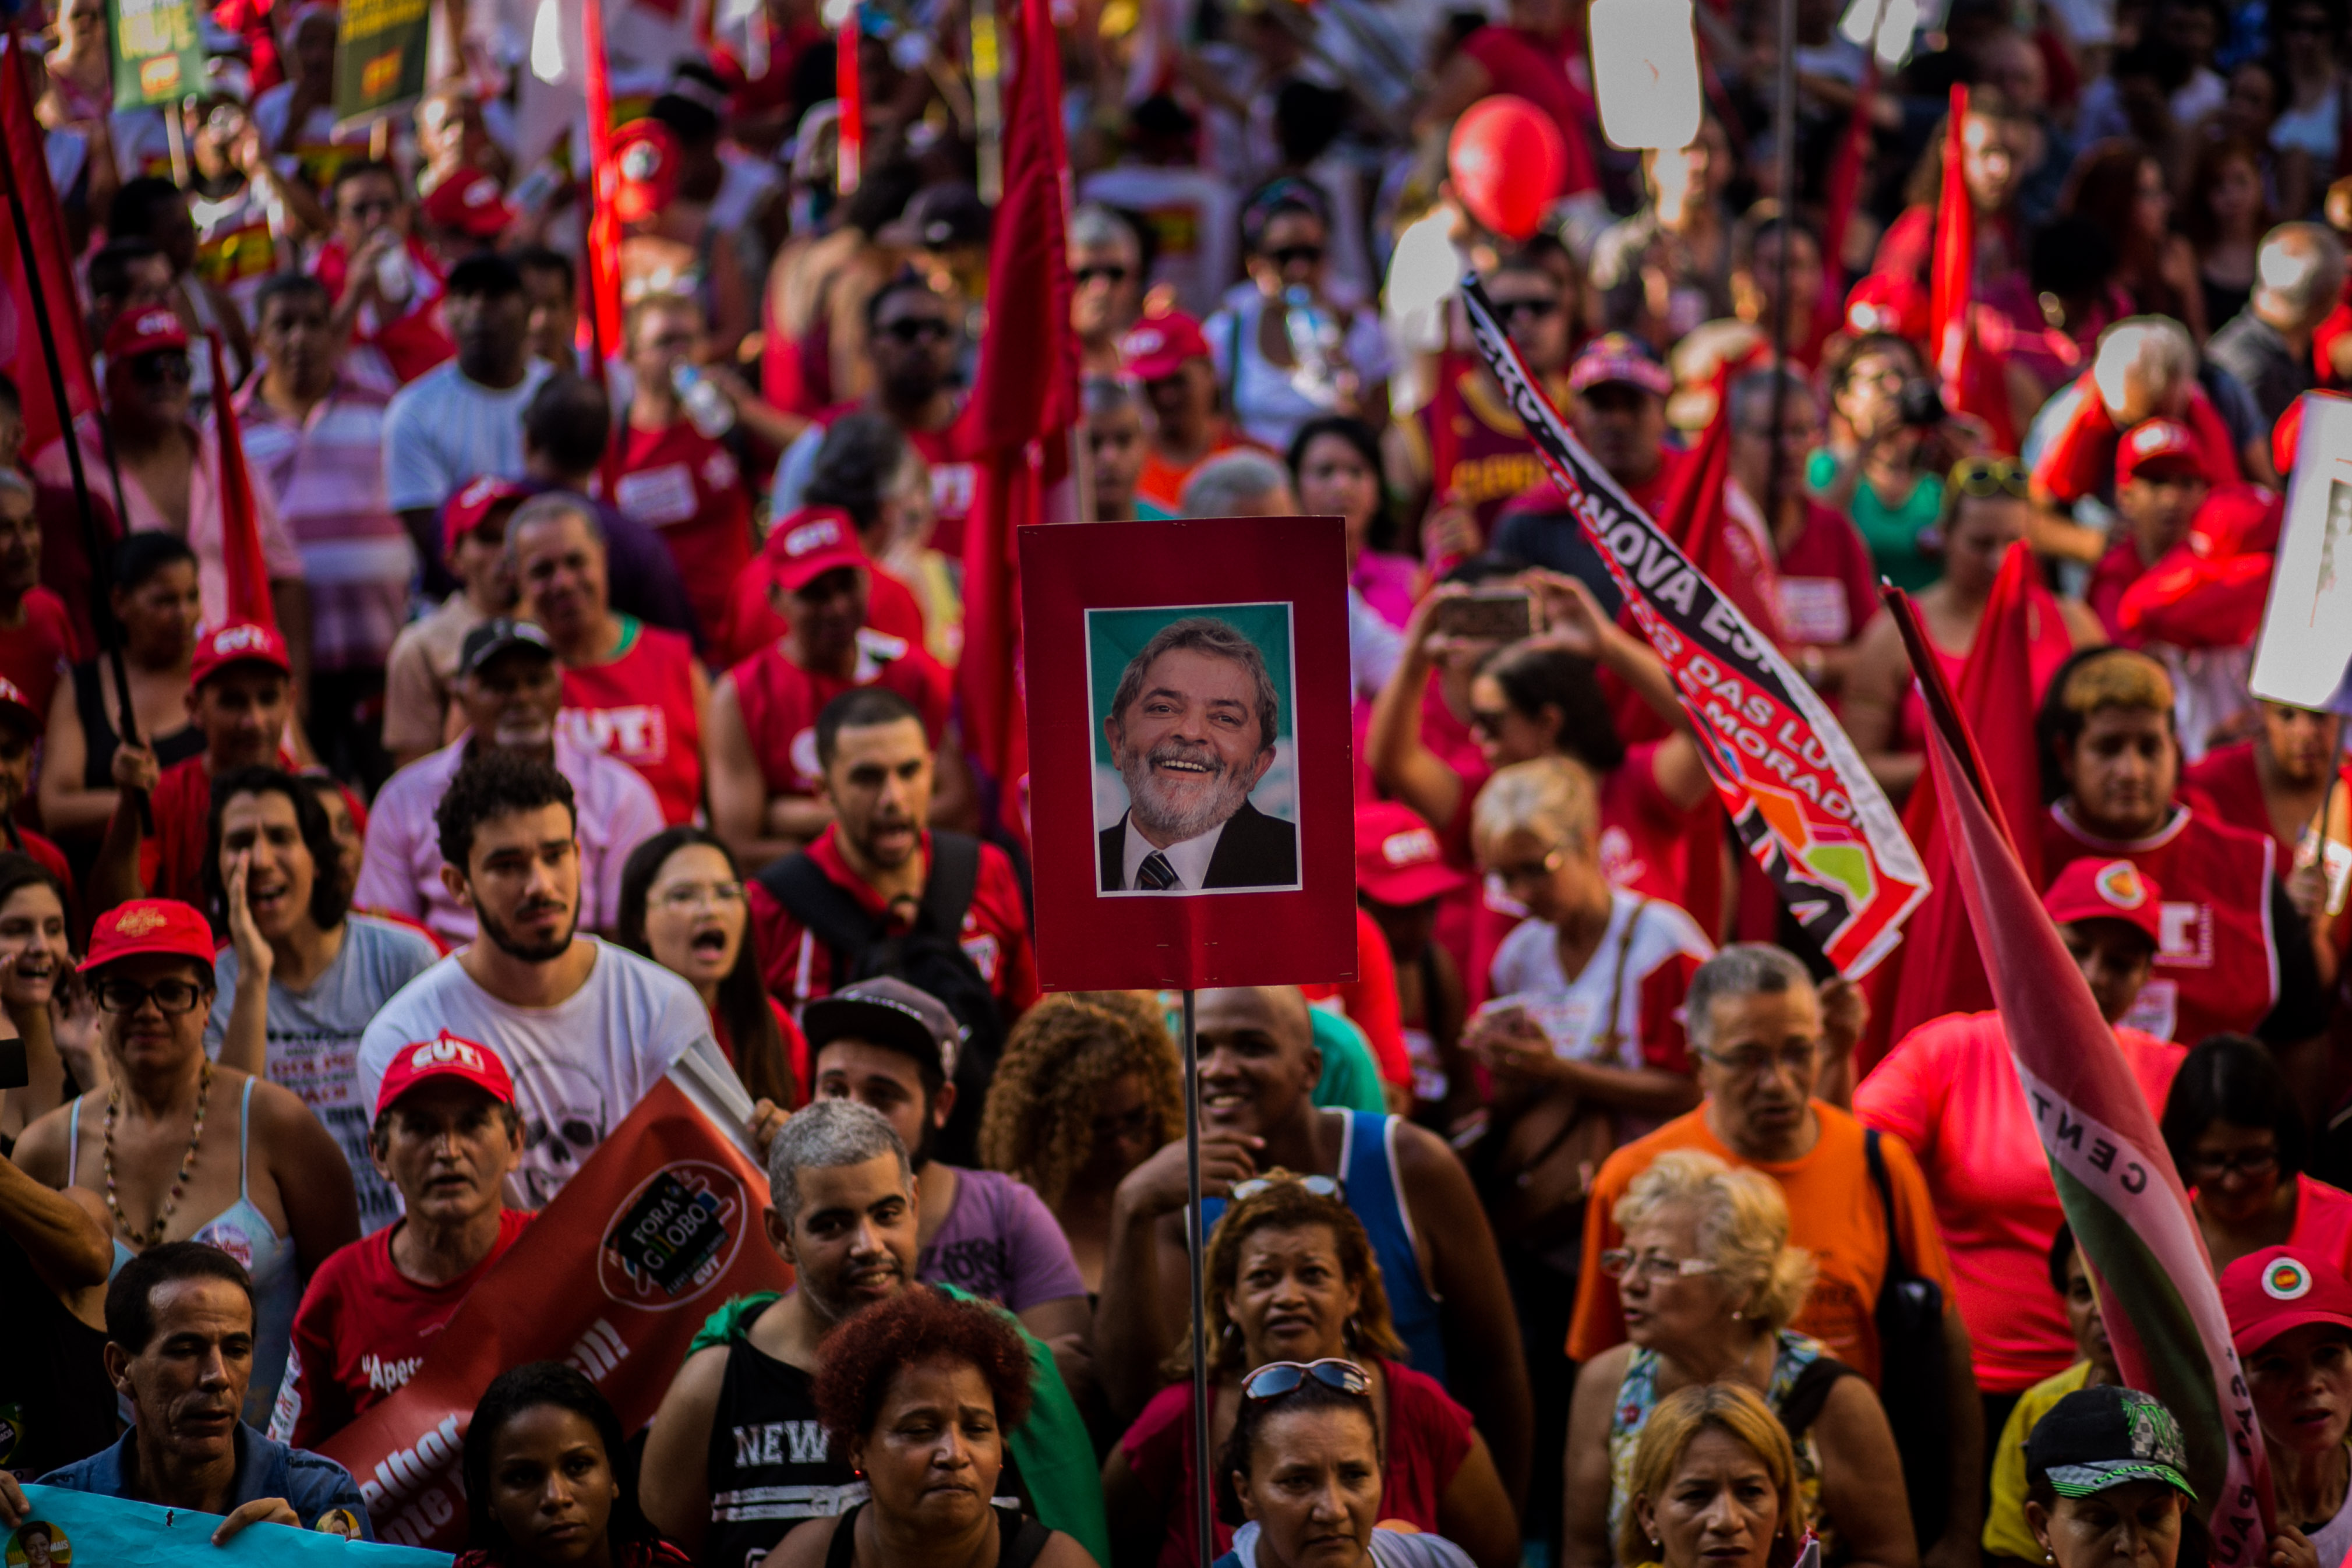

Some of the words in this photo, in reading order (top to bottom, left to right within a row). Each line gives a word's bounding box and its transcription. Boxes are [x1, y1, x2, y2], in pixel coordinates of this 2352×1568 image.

[1581, 493, 1698, 617] NOVA
[1689, 654, 1776, 729] DAS
[1775, 718, 1845, 786] LU
[1704, 698, 1863, 828] MORAD
[411, 1037, 481, 1068] CUT
[630, 1197, 681, 1246] FORA
[732, 1419, 831, 1468] NEW
[50, 1539, 69, 1553] MAIS
